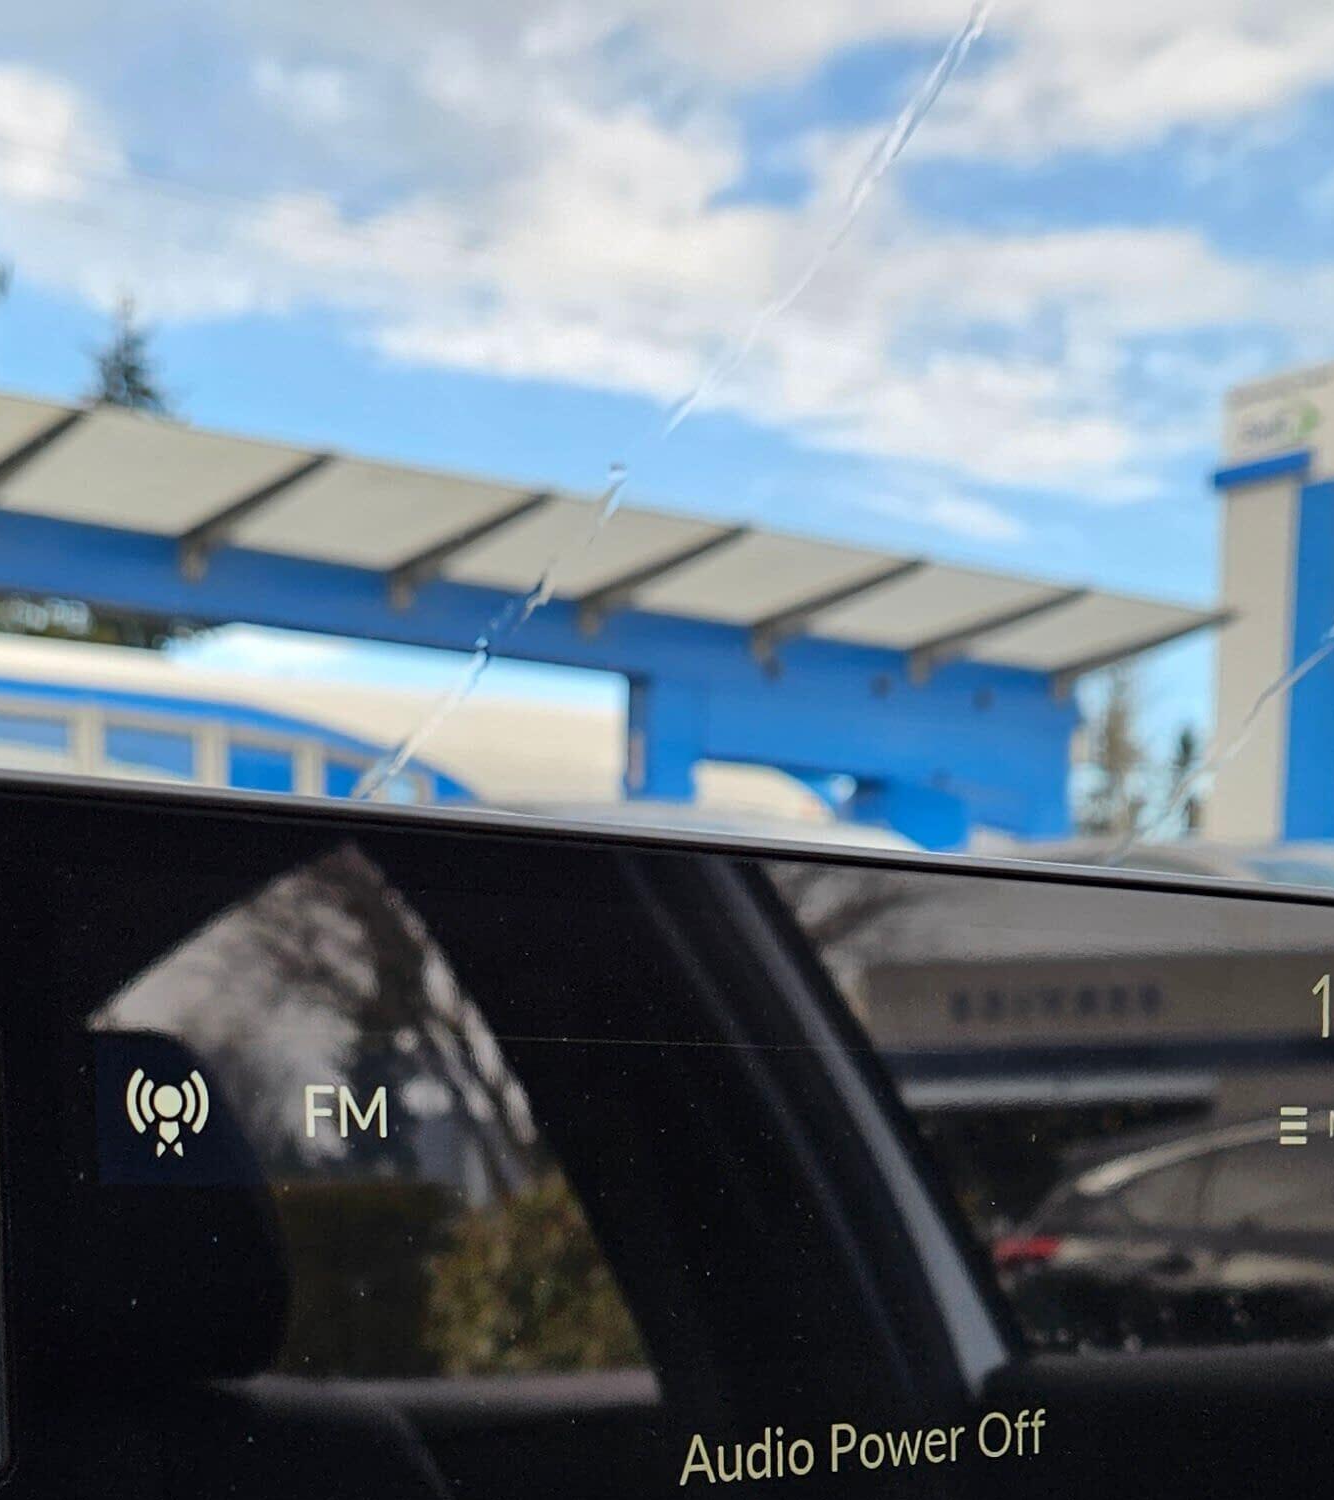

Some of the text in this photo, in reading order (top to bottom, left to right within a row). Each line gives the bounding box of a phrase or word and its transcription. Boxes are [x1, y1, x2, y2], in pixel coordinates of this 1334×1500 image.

[304, 1085, 388, 1138] FM
[679, 1409, 1046, 1486] Audio Power Off
